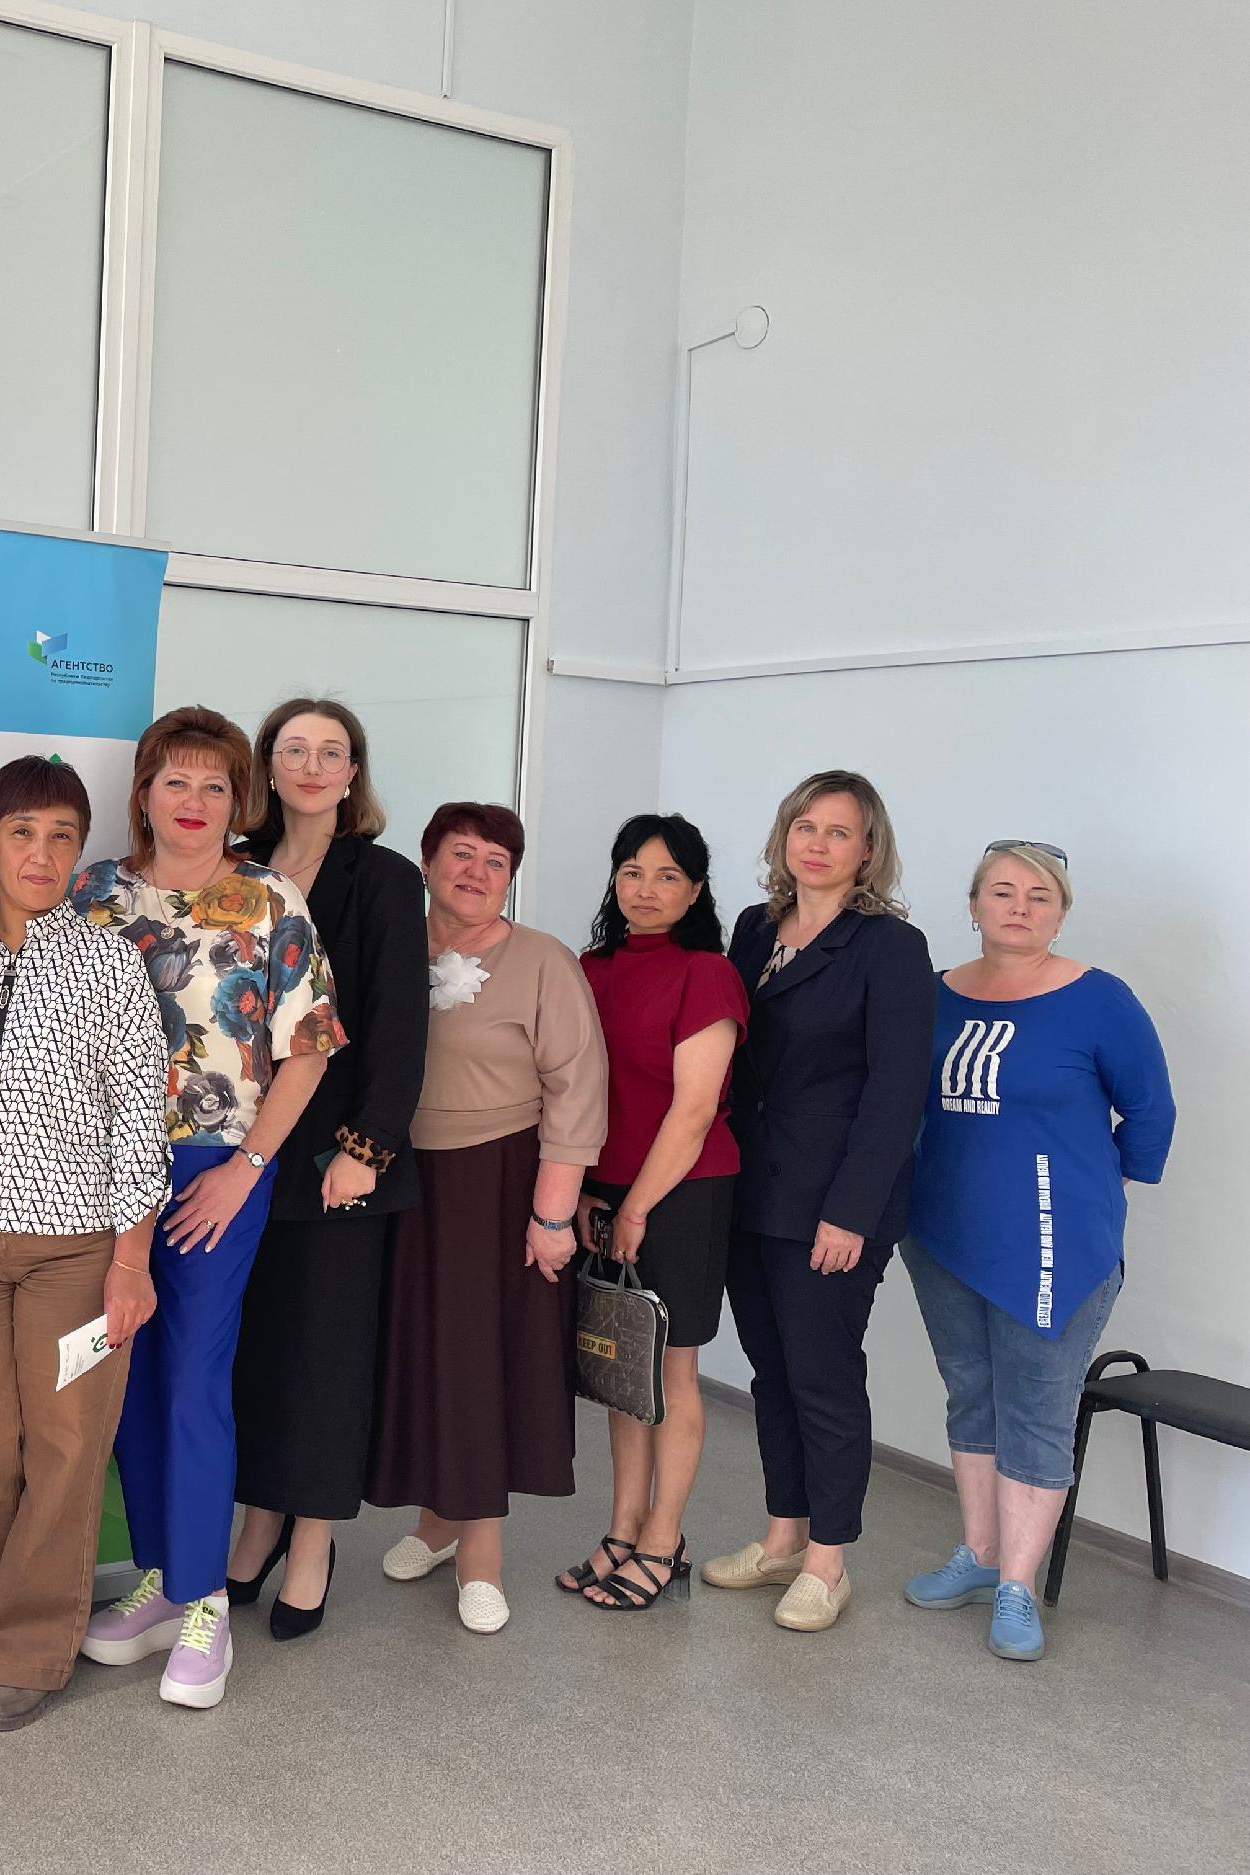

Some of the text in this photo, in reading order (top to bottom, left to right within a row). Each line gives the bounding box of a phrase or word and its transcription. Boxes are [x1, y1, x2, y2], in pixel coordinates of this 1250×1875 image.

[51, 659, 114, 673] АГЕНТСТВО
[941, 1019, 1016, 1100] DR
[941, 1097, 1000, 1115] DREAM AND REALITY
[598, 1342, 613, 1356] OUT
